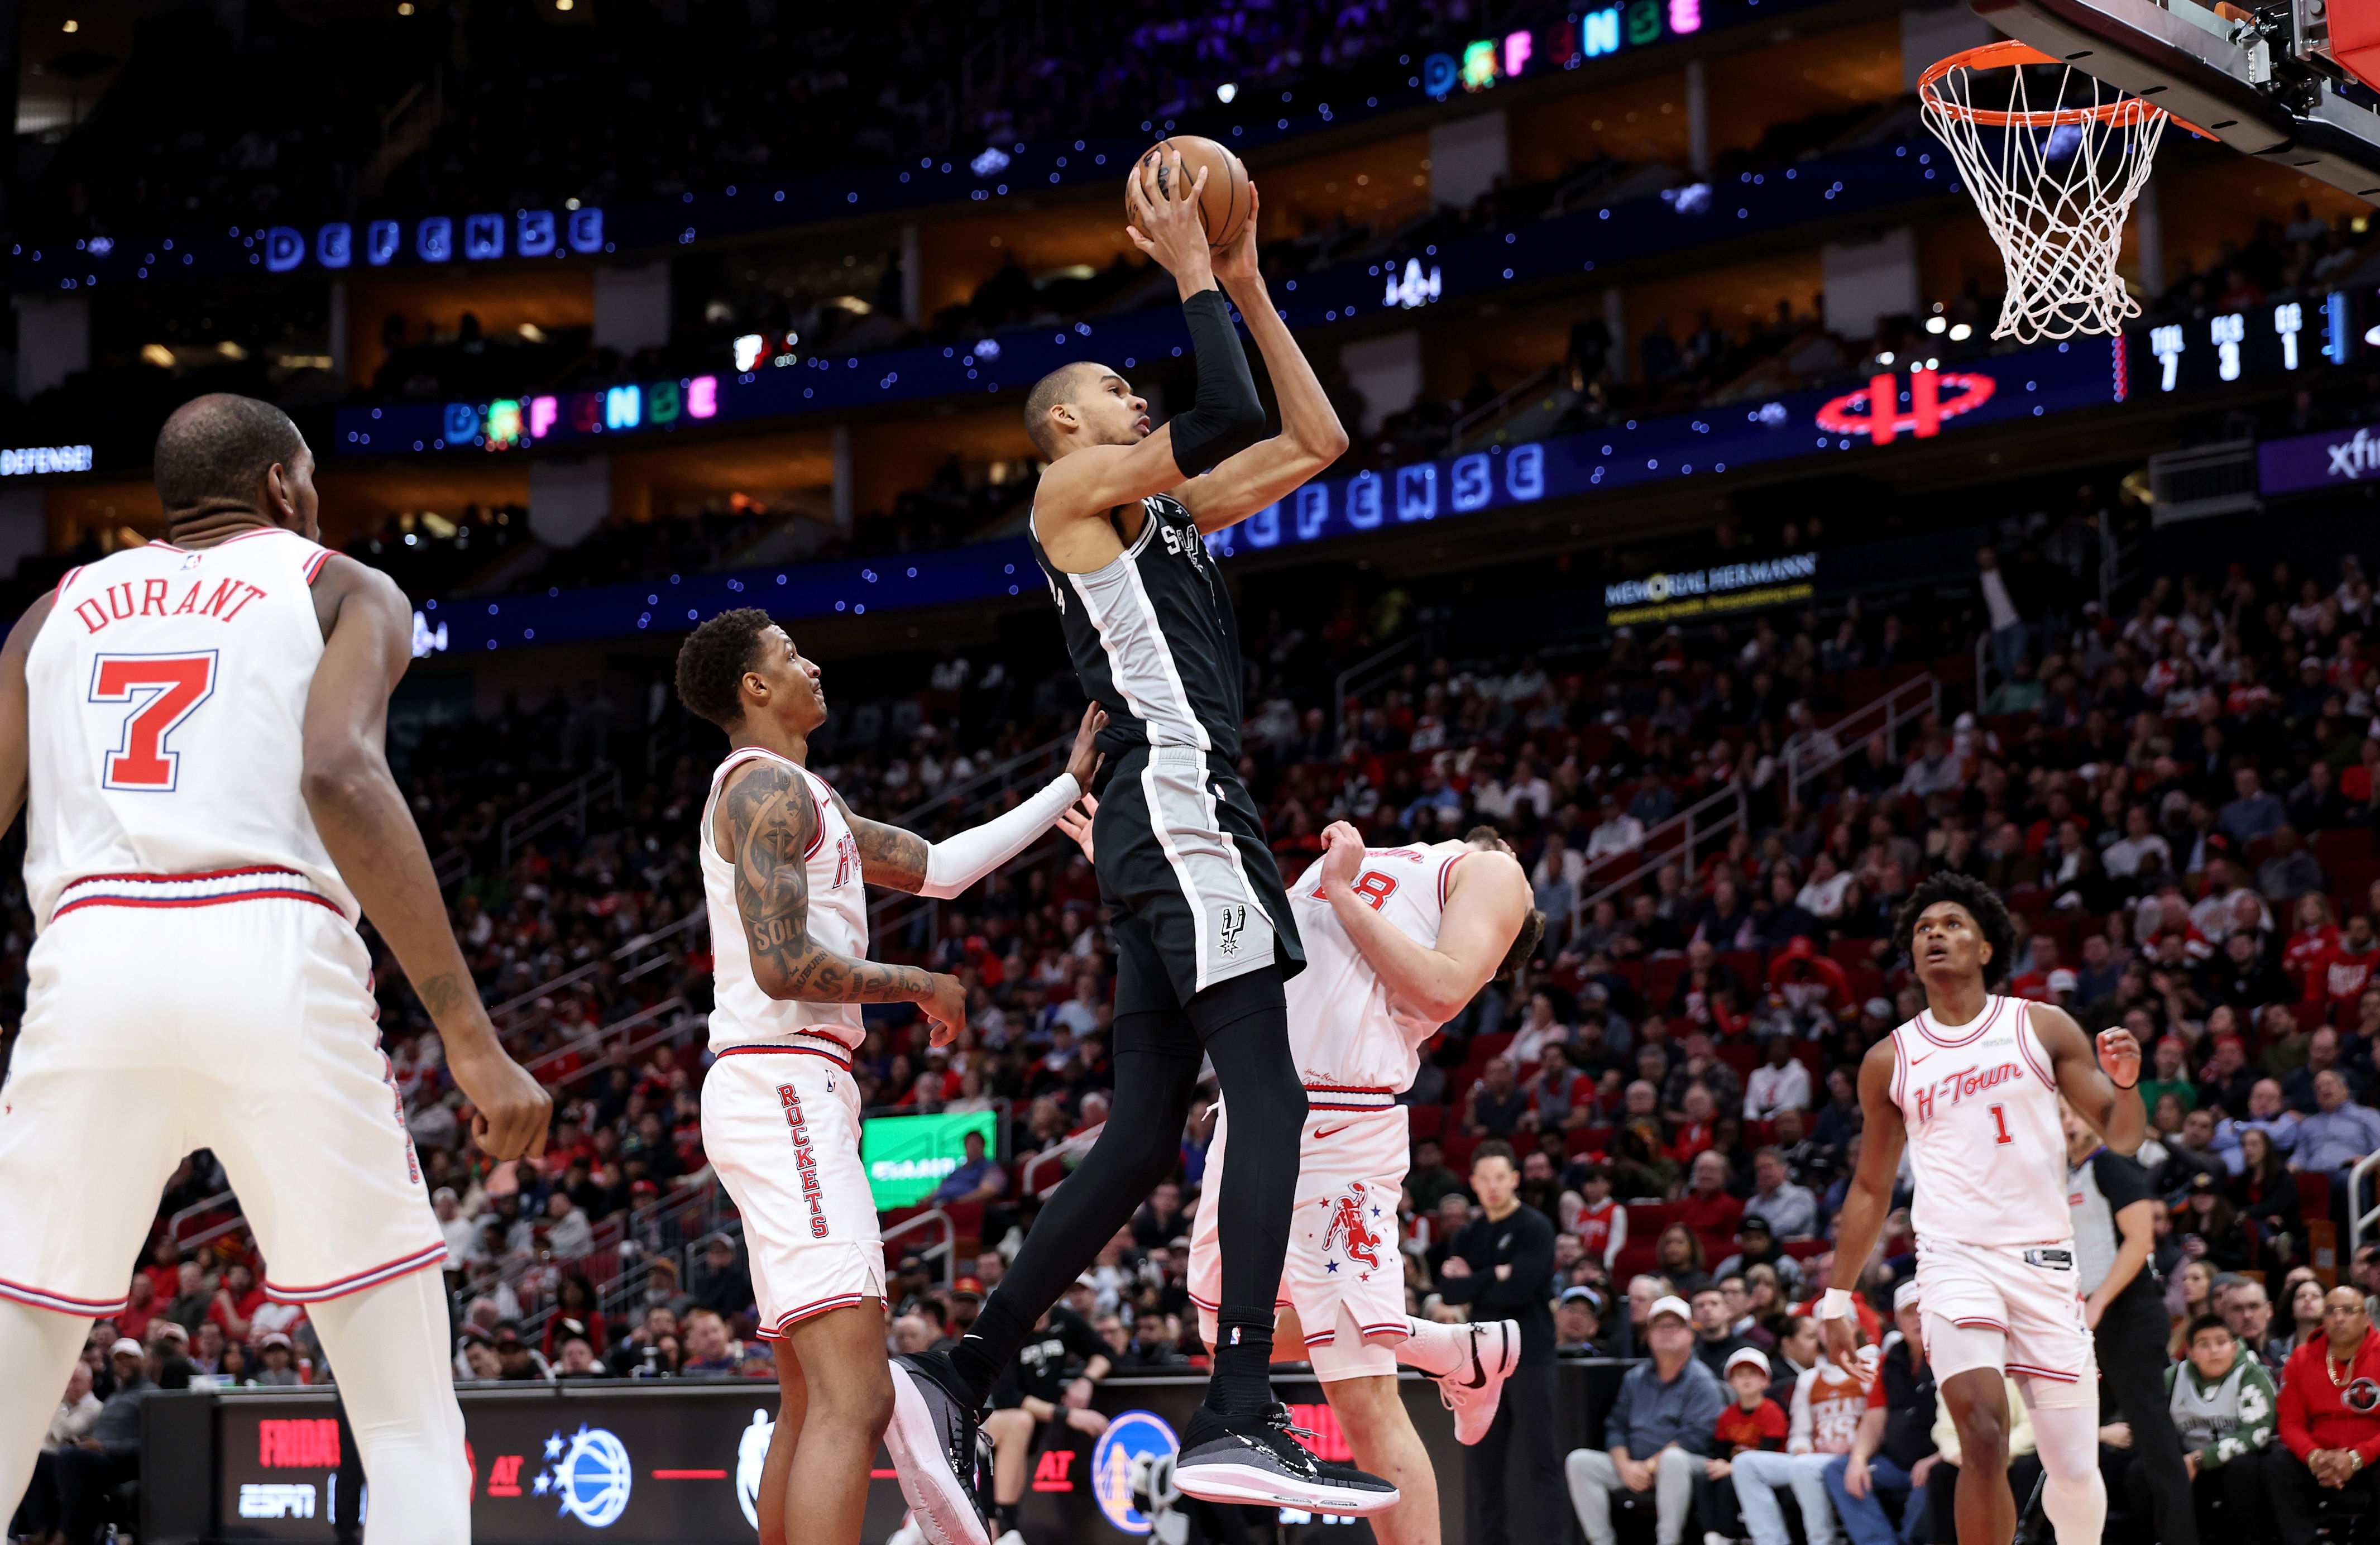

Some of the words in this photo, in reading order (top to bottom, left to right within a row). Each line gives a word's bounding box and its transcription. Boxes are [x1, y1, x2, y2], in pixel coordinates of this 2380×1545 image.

[266, 207, 604, 272] DEFENSE
[2326, 427, 2380, 479] xfi
[1201, 443, 1544, 547] EFENSE
[74, 577, 268, 634] DURANT
[1605, 570, 1707, 608] MEMORIAL
[1708, 552, 1817, 591] HERMANN
[88, 649, 219, 792] 7
[794, 950, 829, 993] AUBURN
[1914, 1061, 2024, 1124] H-Town
[1987, 1103, 2015, 1147] 1
[776, 1083, 829, 1238] ROCKETS
[259, 1418, 341, 1468] FRIDA
[1036, 1451, 1076, 1481] AT
[238, 1484, 317, 1519] ESPN
